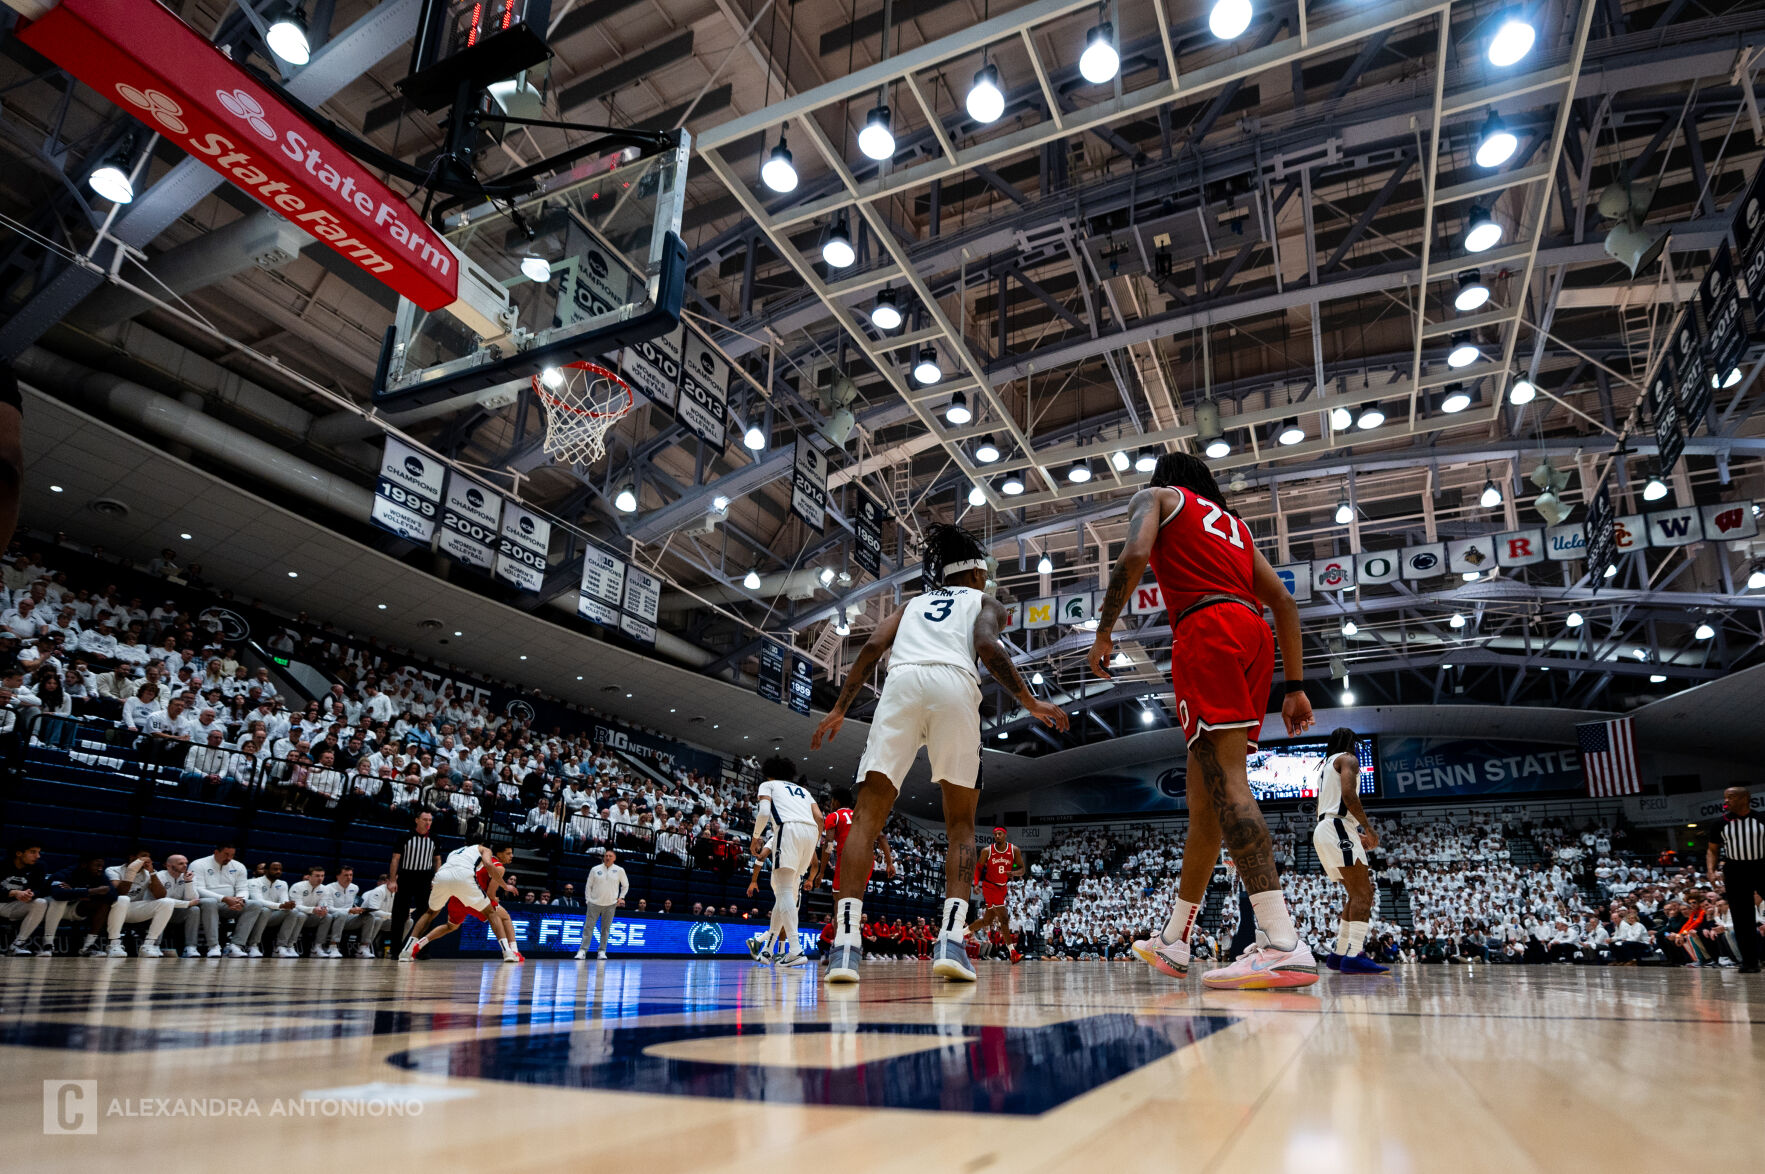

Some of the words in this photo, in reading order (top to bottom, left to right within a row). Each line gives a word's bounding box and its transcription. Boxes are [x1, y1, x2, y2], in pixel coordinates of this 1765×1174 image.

[189, 133, 306, 212] State
[296, 209, 394, 274] Farm
[281, 131, 374, 216] State
[374, 202, 451, 276] Farm
[631, 365, 670, 400] VOLLEYBALL
[687, 360, 725, 396] CHAMPIONS
[684, 378, 723, 419] 2013
[685, 410, 718, 438] VOLLEYBALL
[690, 406, 716, 430] WOMEN'S
[406, 462, 424, 476] NCAA
[386, 465, 438, 496] CHAMPIONS
[796, 474, 824, 504] 2014
[382, 482, 436, 516] 1999
[390, 508, 422, 528] WOMEN'S
[452, 498, 496, 524] CHAMPIONS
[382, 512, 426, 536] VOLLEYBALL
[444, 513, 496, 544] 2007
[1196, 498, 1244, 550] 21
[1657, 516, 1692, 538] W
[453, 538, 482, 555] WOMEN'S
[506, 526, 546, 550] CHAMPIONS
[857, 525, 881, 552] 1960
[1507, 538, 1534, 558] R
[448, 542, 486, 562] VOLLEYBALL
[500, 540, 546, 570] 2008
[504, 567, 536, 586] VOLLEYBALL
[508, 564, 534, 578] WOMEN'S
[588, 558, 622, 578] CHAMPIONS
[1364, 558, 1390, 577] O
[629, 578, 658, 596] CHAMPIONS
[929, 588, 954, 597] KERN
[589, 600, 611, 614] WOMEN'S
[1138, 588, 1158, 608] N
[585, 606, 612, 620] VOLLEYBALL
[924, 598, 954, 622] 3
[1028, 604, 1050, 623] M
[791, 681, 811, 696] 1959
[1384, 758, 1410, 773] WE
[1414, 754, 1446, 769] ARE
[1396, 762, 1477, 793] PENN
[1484, 748, 1582, 782] STATE
[784, 786, 806, 798] 14
[1640, 798, 1668, 810] PSECU
[1022, 828, 1040, 838] PSECU
[998, 866, 1005, 874] 8
